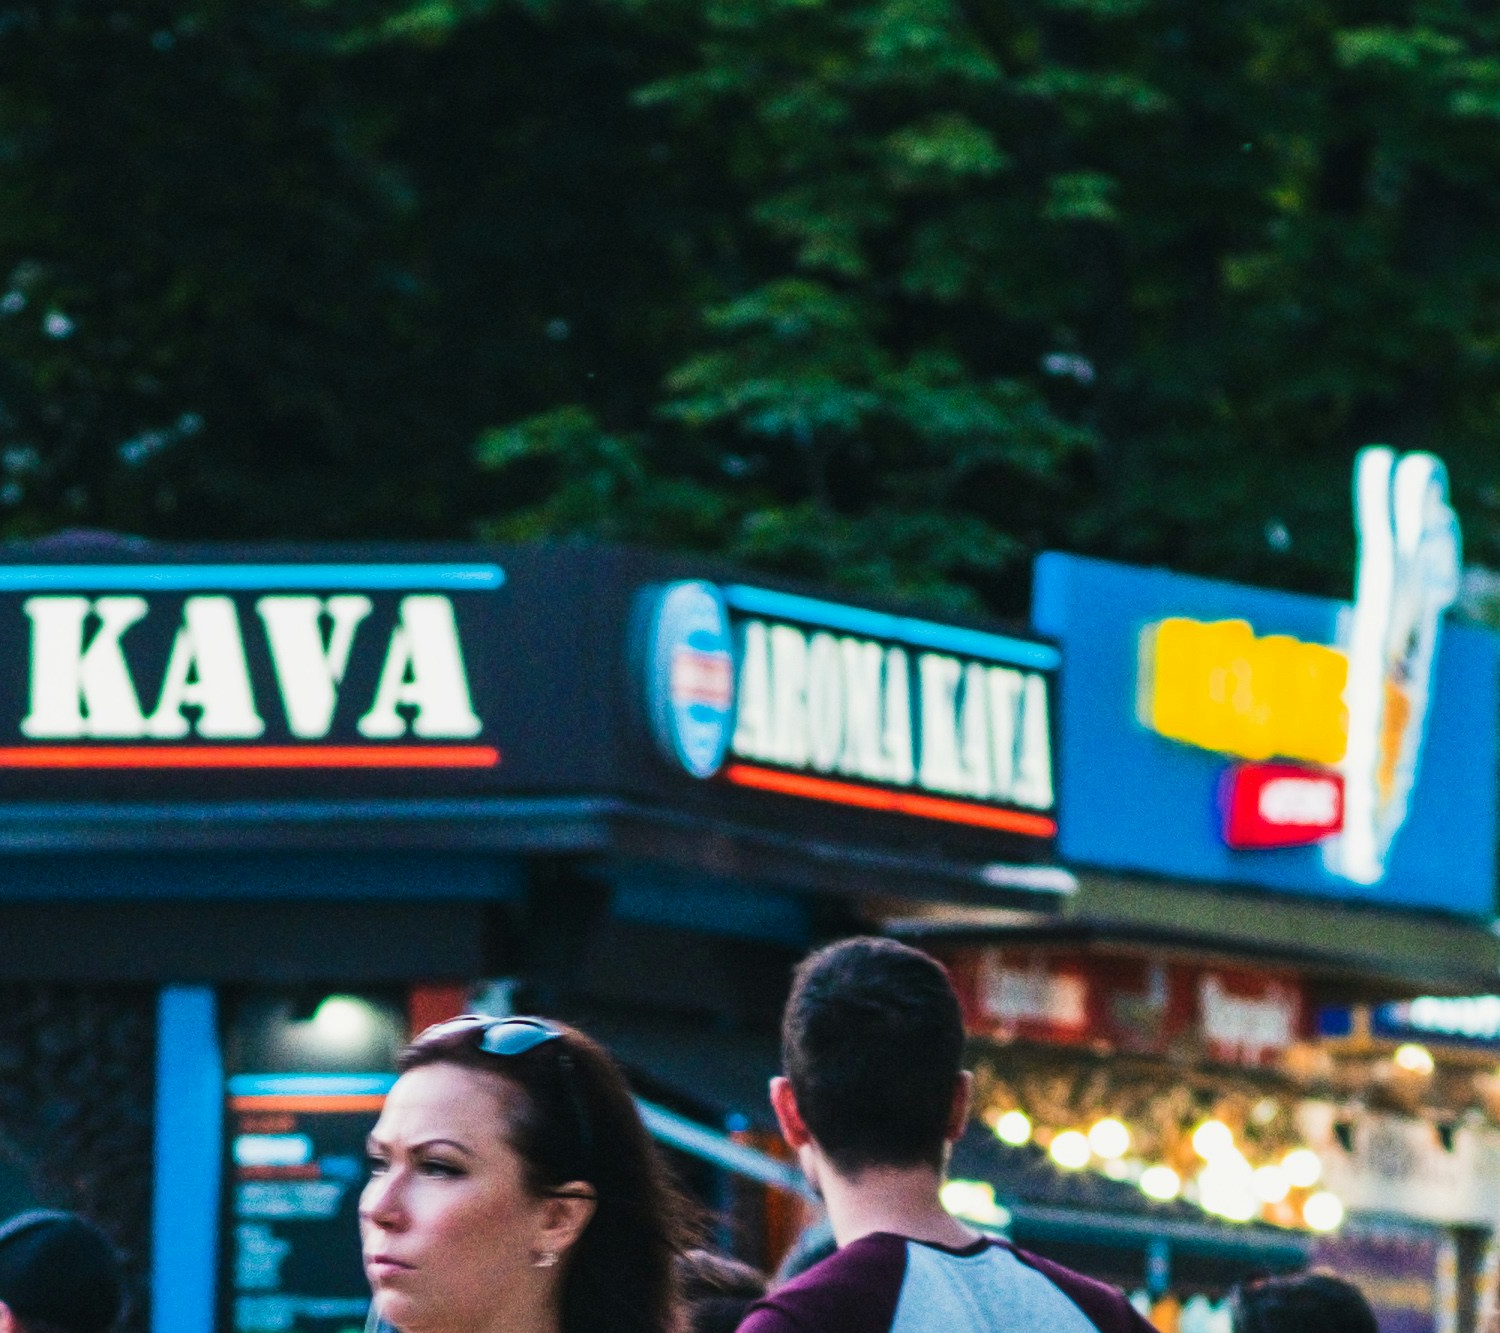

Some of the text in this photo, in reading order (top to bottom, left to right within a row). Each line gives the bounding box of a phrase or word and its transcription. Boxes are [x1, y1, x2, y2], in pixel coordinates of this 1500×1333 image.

[21, 596, 480, 737] KAVA
[734, 621, 914, 786] AROMA
[919, 654, 1053, 810] KAVA
